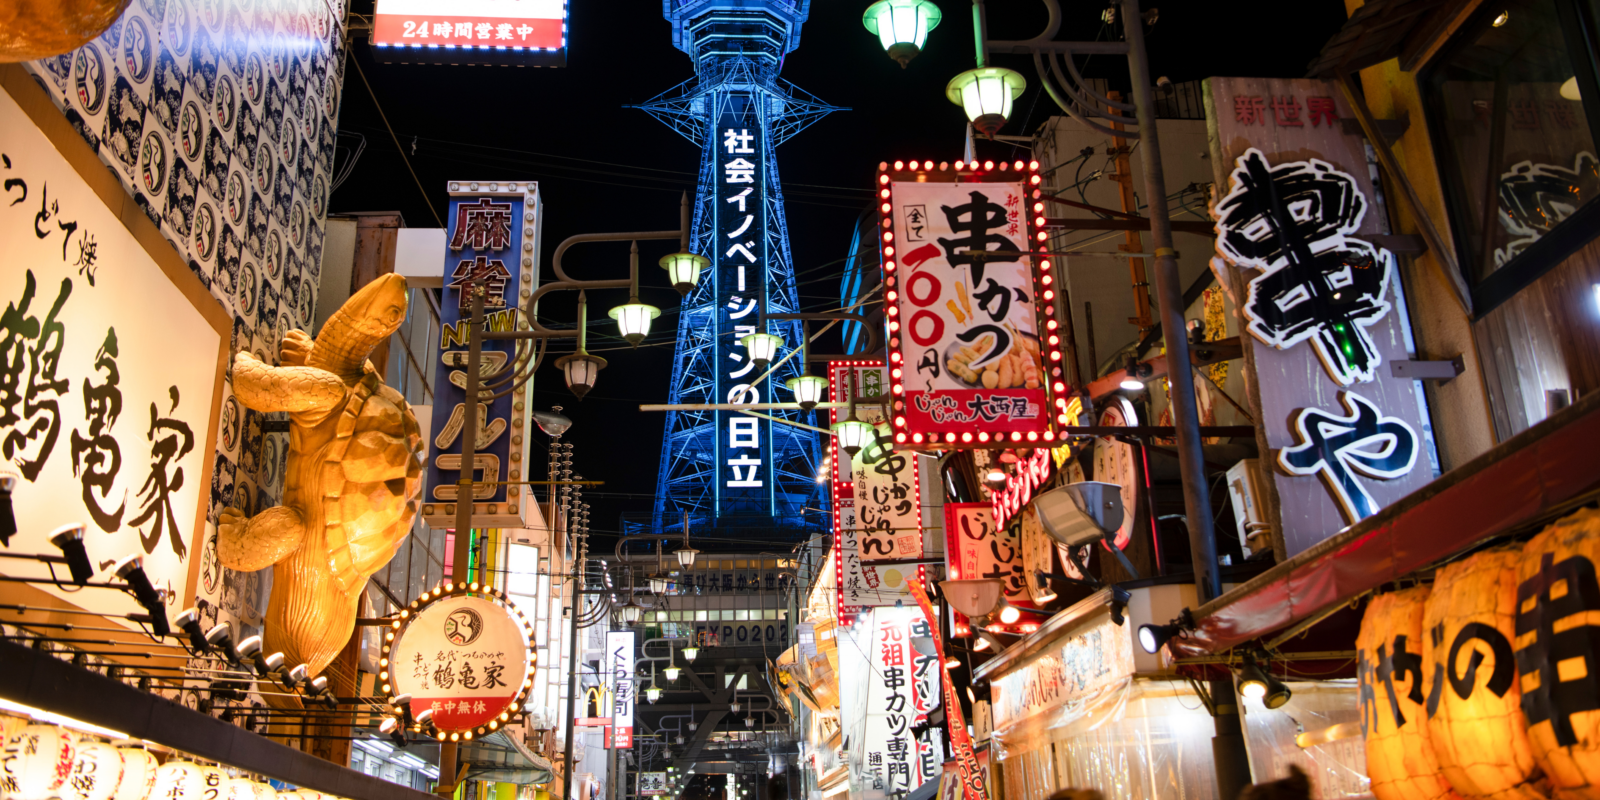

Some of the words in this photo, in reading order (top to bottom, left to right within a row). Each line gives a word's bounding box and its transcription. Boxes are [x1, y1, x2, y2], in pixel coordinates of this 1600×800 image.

[402, 20, 534, 41] 24時間営業中
[1233, 95, 1339, 128] 新世界
[906, 207, 925, 239] 全て
[446, 198, 513, 310] 麻雀
[936, 190, 1030, 369] 串かつ
[723, 128, 763, 488] 社会イノベーションの日立
[0, 268, 196, 564] 鶴亀家
[856, 467, 869, 501] 味自慢
[432, 660, 508, 690] 鶴亀家
[430, 700, 487, 715] 年中無休
[165, 767, 188, 800] ハイボ
